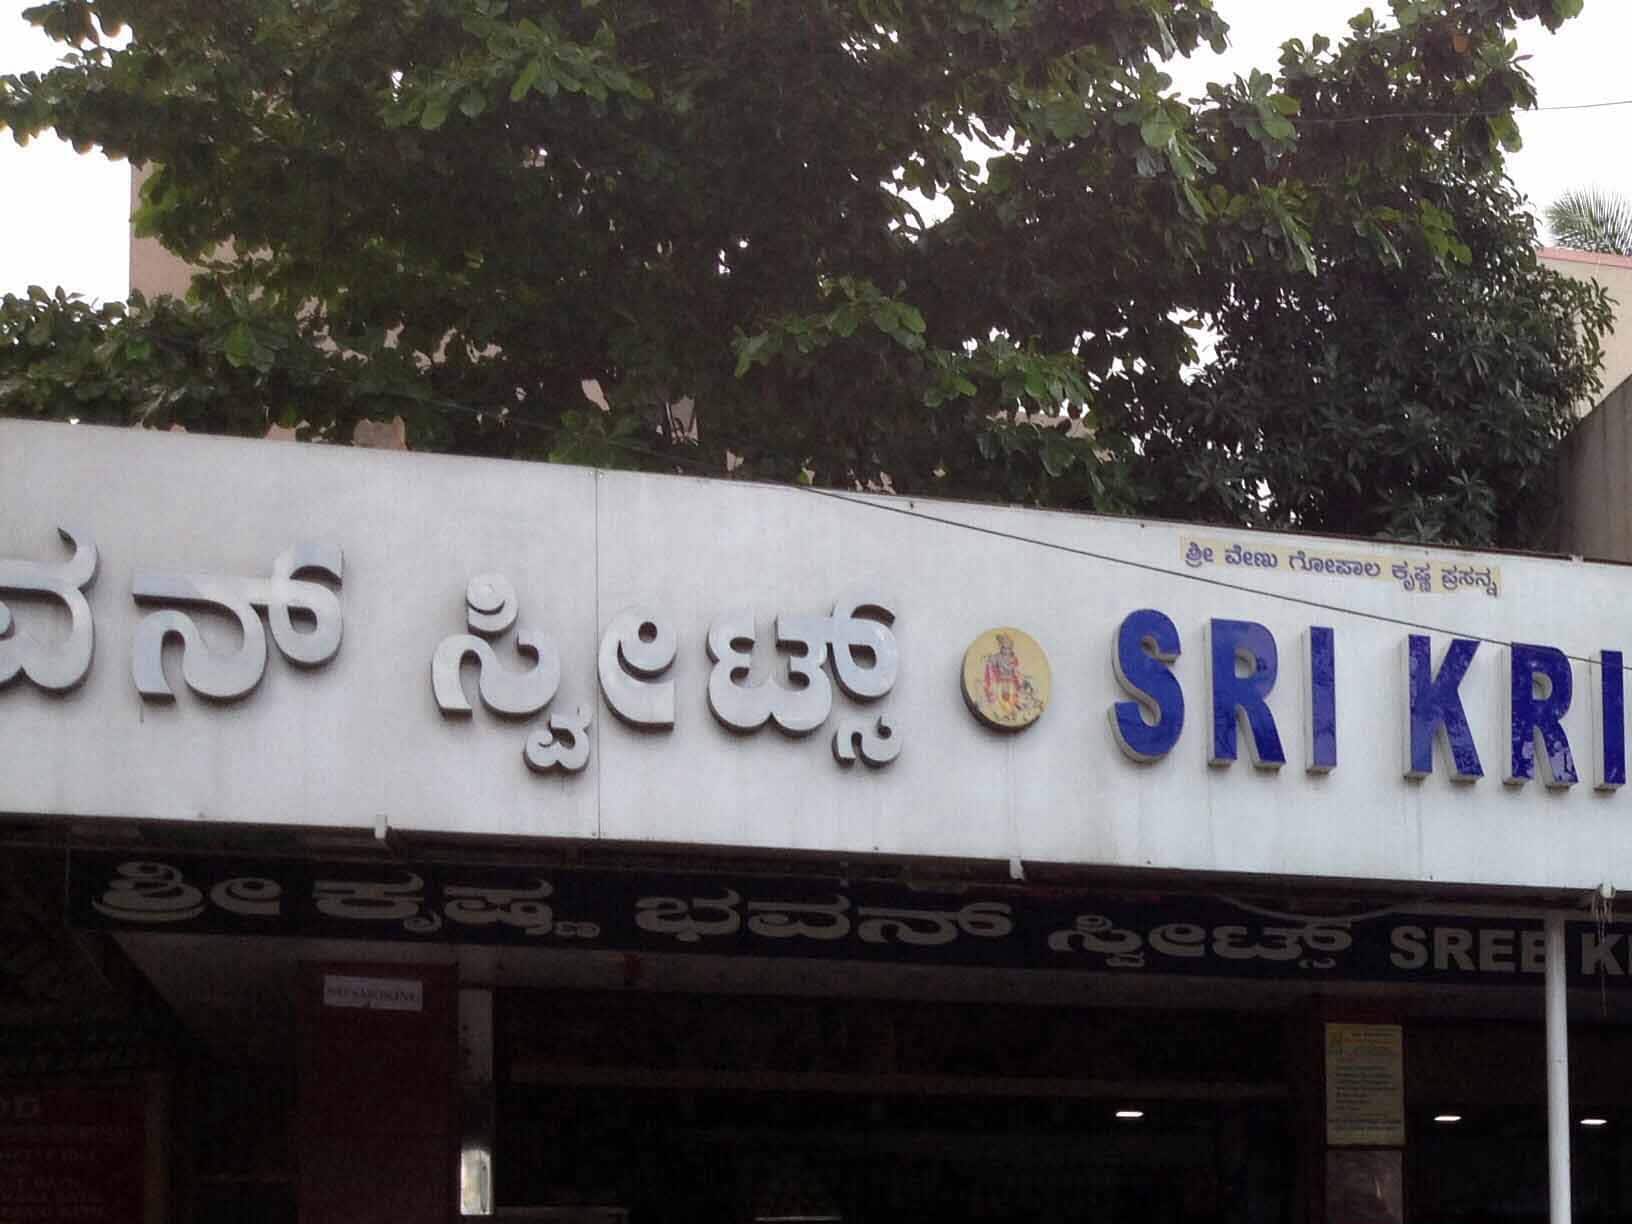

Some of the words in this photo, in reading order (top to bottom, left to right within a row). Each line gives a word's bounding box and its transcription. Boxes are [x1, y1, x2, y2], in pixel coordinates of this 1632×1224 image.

[1185, 541, 1215, 568] ಶ್ರೀ
[1225, 543, 1279, 569] ವೇಣು
[1288, 550, 1382, 577] ಗೋಪಾಲ
[1391, 564, 1433, 592] ಕೃಷ್ಣ
[1440, 566, 1500, 597] ಪ್ರಸನ್ನ
[1110, 608, 1338, 775] SRI
[92, 860, 281, 924] ಶ್ರೀ
